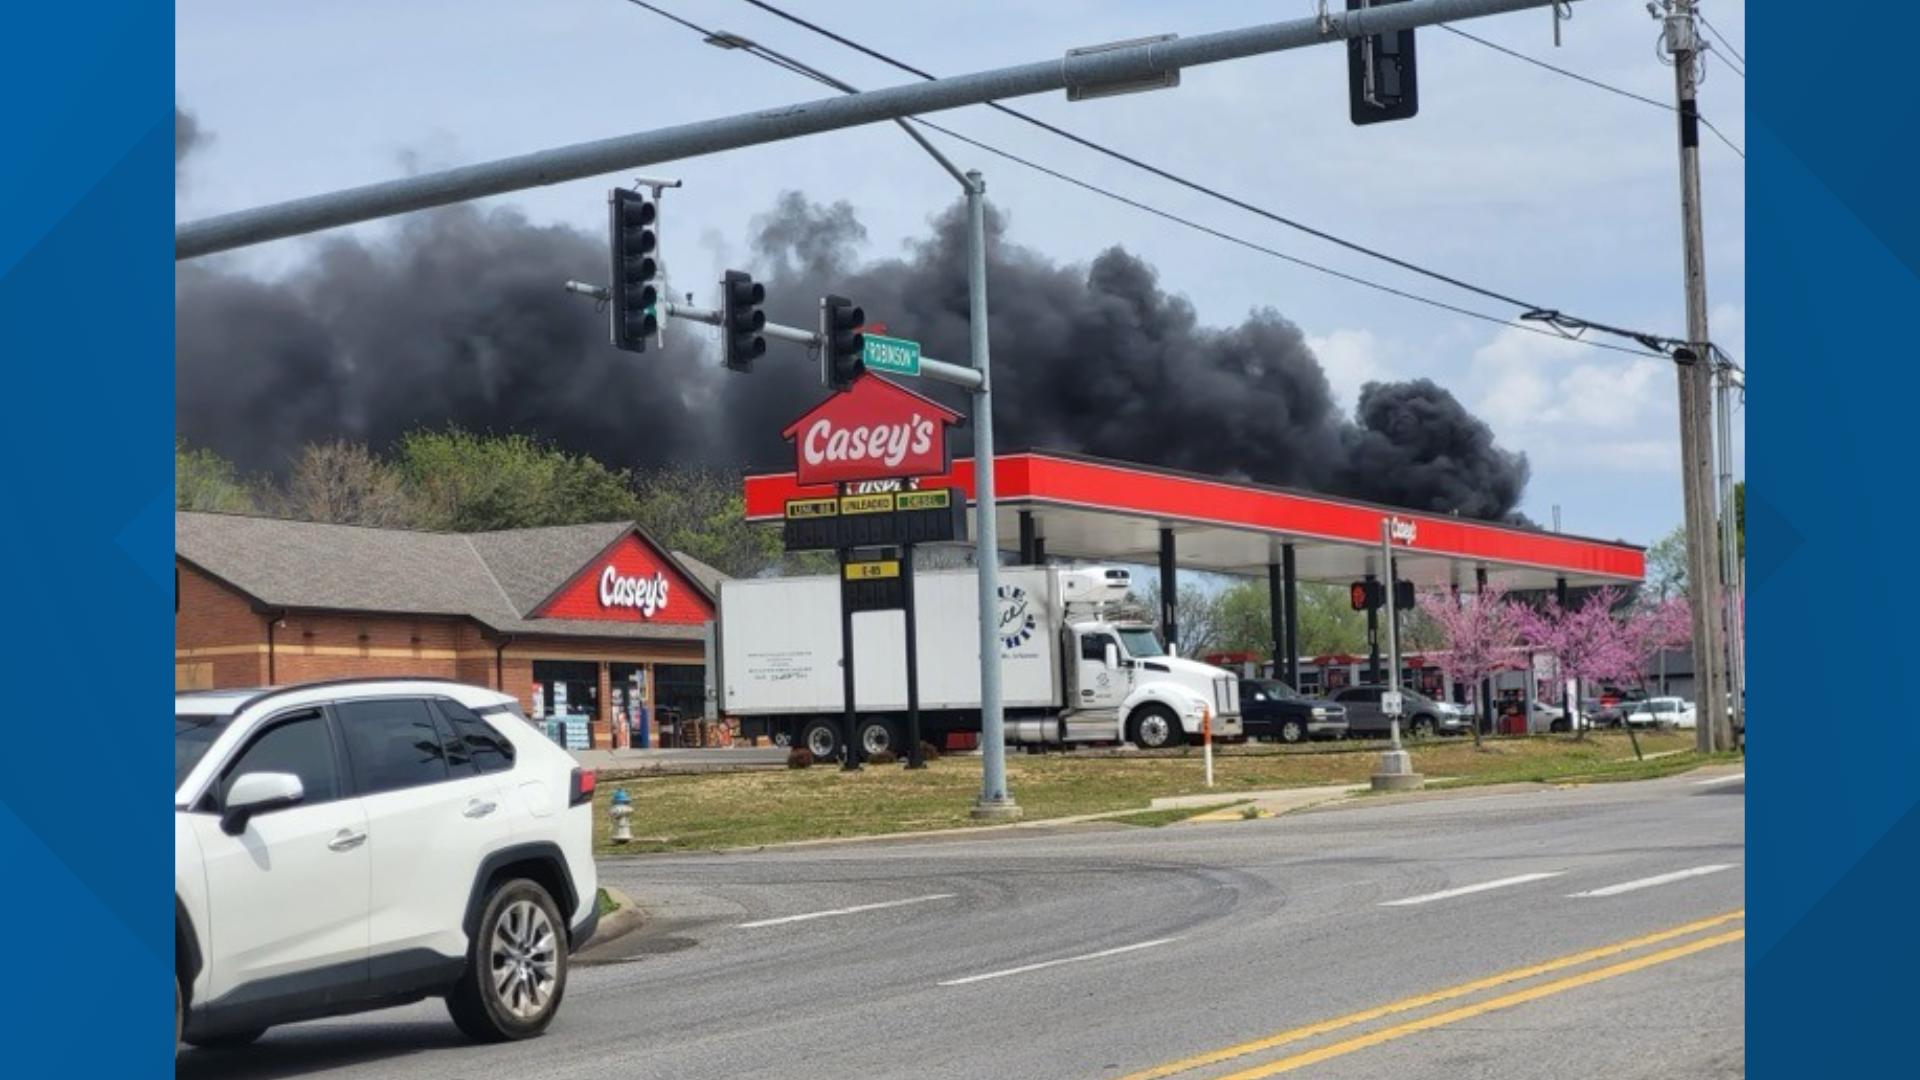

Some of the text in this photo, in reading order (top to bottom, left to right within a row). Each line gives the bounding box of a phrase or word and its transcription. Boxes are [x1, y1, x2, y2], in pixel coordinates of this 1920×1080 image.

[868, 341, 911, 367] ROBINSON
[804, 413, 934, 467] Casey's
[600, 565, 669, 618] Casey's
